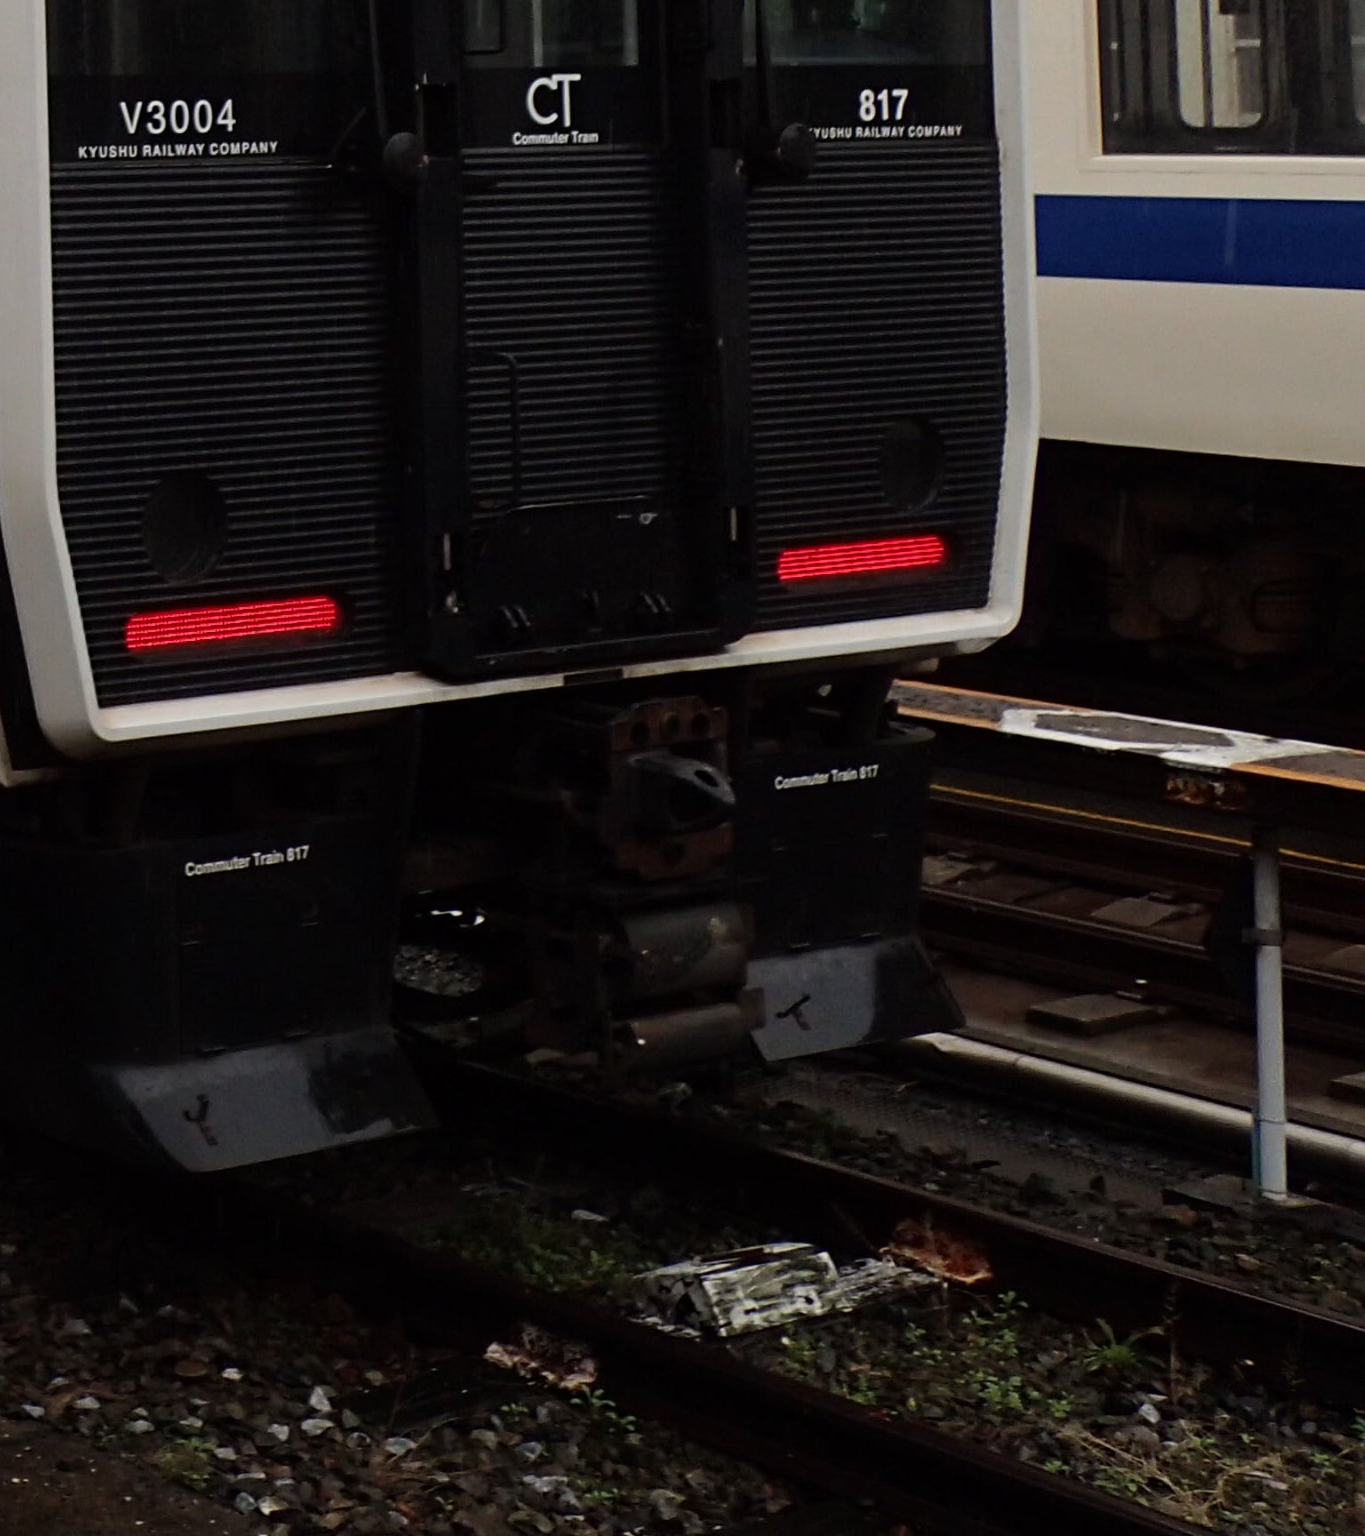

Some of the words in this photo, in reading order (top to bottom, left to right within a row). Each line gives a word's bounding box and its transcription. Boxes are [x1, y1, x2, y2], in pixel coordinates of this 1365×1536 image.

[526, 73, 582, 128] CT
[859, 88, 909, 121] 817
[120, 98, 236, 134] V3004
[512, 132, 569, 145] Commuter
[571, 131, 599, 144] Train
[808, 127, 852, 139] YUSHU
[855, 126, 905, 138] RAILWAY
[908, 124, 962, 137] COMPANY
[78, 145, 138, 159] KYUSHU
[142, 143, 205, 157] RAILWAY
[209, 140, 278, 155] COMPANY
[774, 773, 829, 790] Commuter
[830, 768, 858, 782] Train
[859, 764, 879, 779] 817
[185, 856, 251, 876] Commuter
[252, 850, 285, 866] Train
[286, 845, 310, 862] 817
